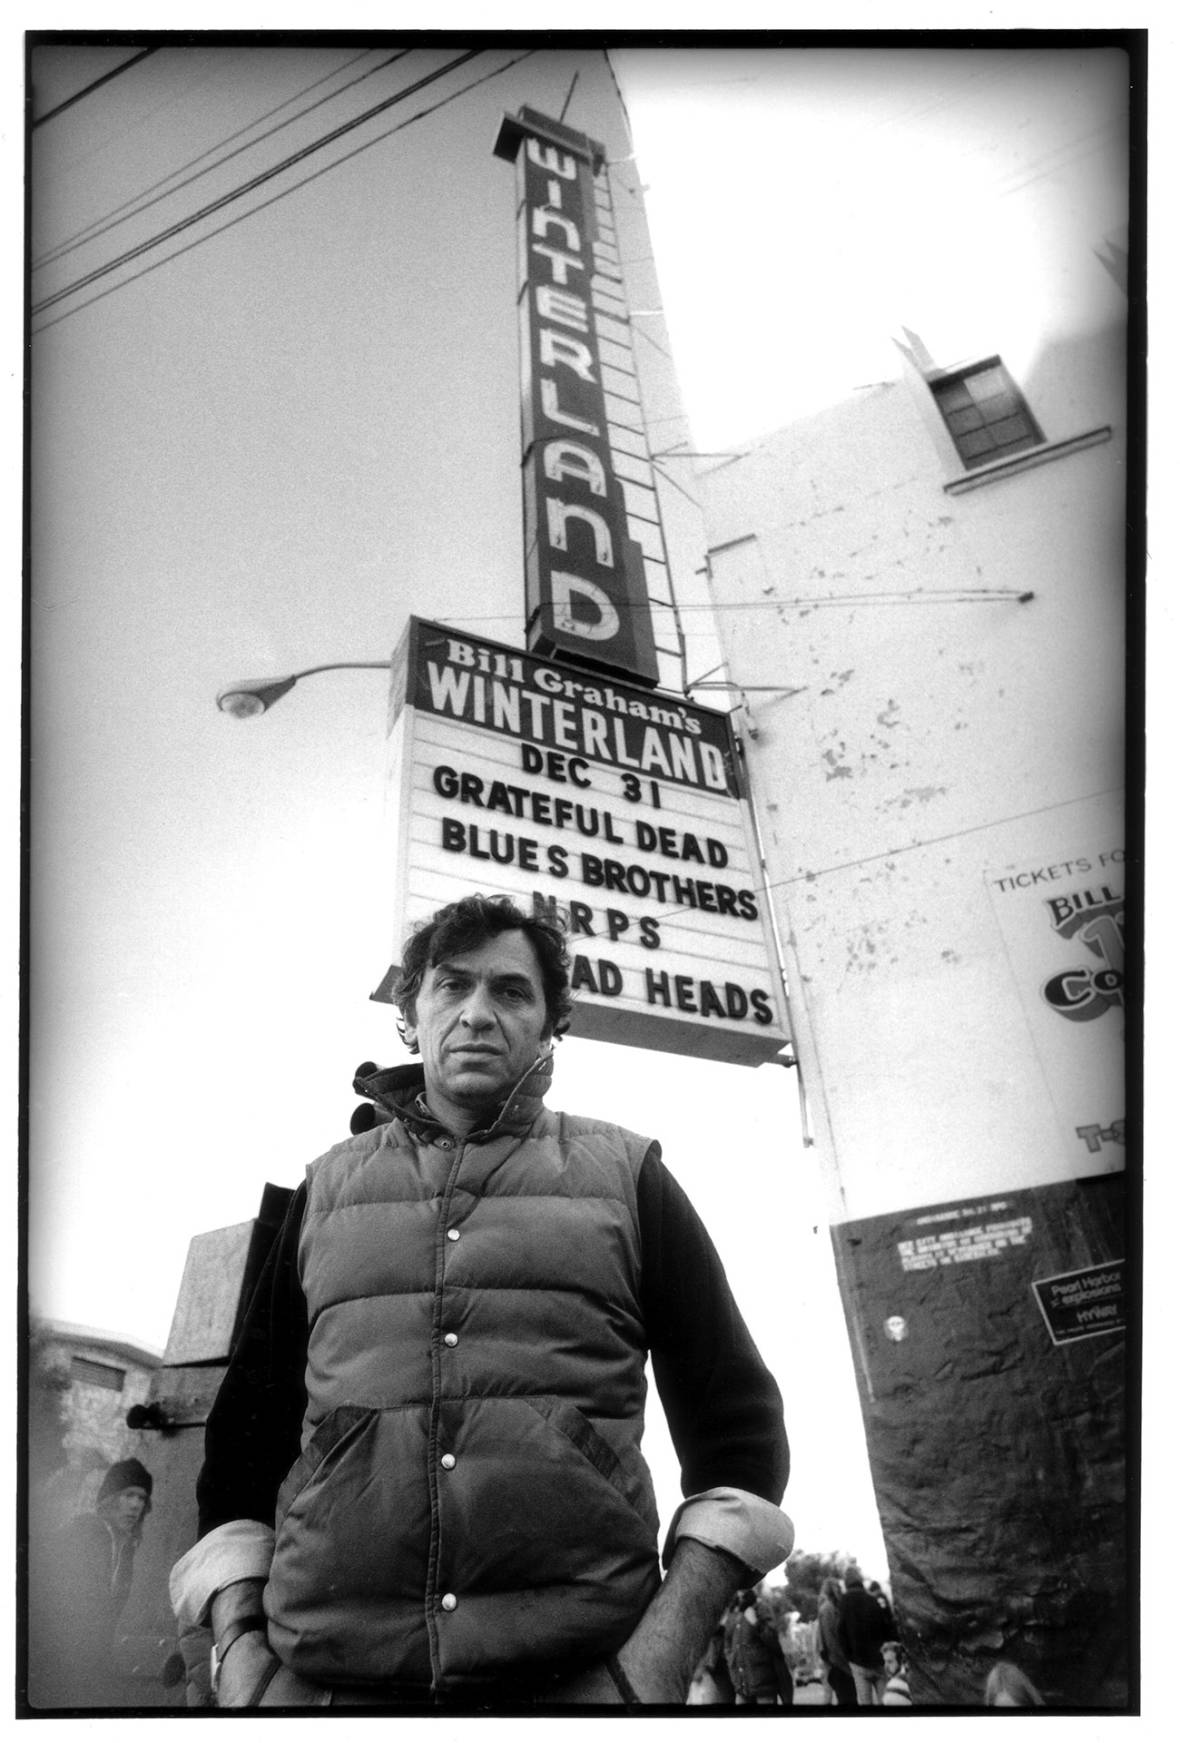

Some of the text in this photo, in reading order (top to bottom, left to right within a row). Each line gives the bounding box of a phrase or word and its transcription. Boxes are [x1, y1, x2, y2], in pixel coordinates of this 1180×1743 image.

[447, 639, 702, 735] Bill Graham's
[427, 661, 729, 791] WINTERLAND
[521, 743, 661, 808] DEC 31
[433, 766, 729, 869] GRATEFUL DEAD
[442, 817, 758, 921] BLUES BROTHERS
[994, 850, 1125, 892] TICKETS FO
[1047, 885, 1122, 928] BILL
[571, 954, 773, 1024] AD HEADS
[1043, 968, 1125, 1008] CO
